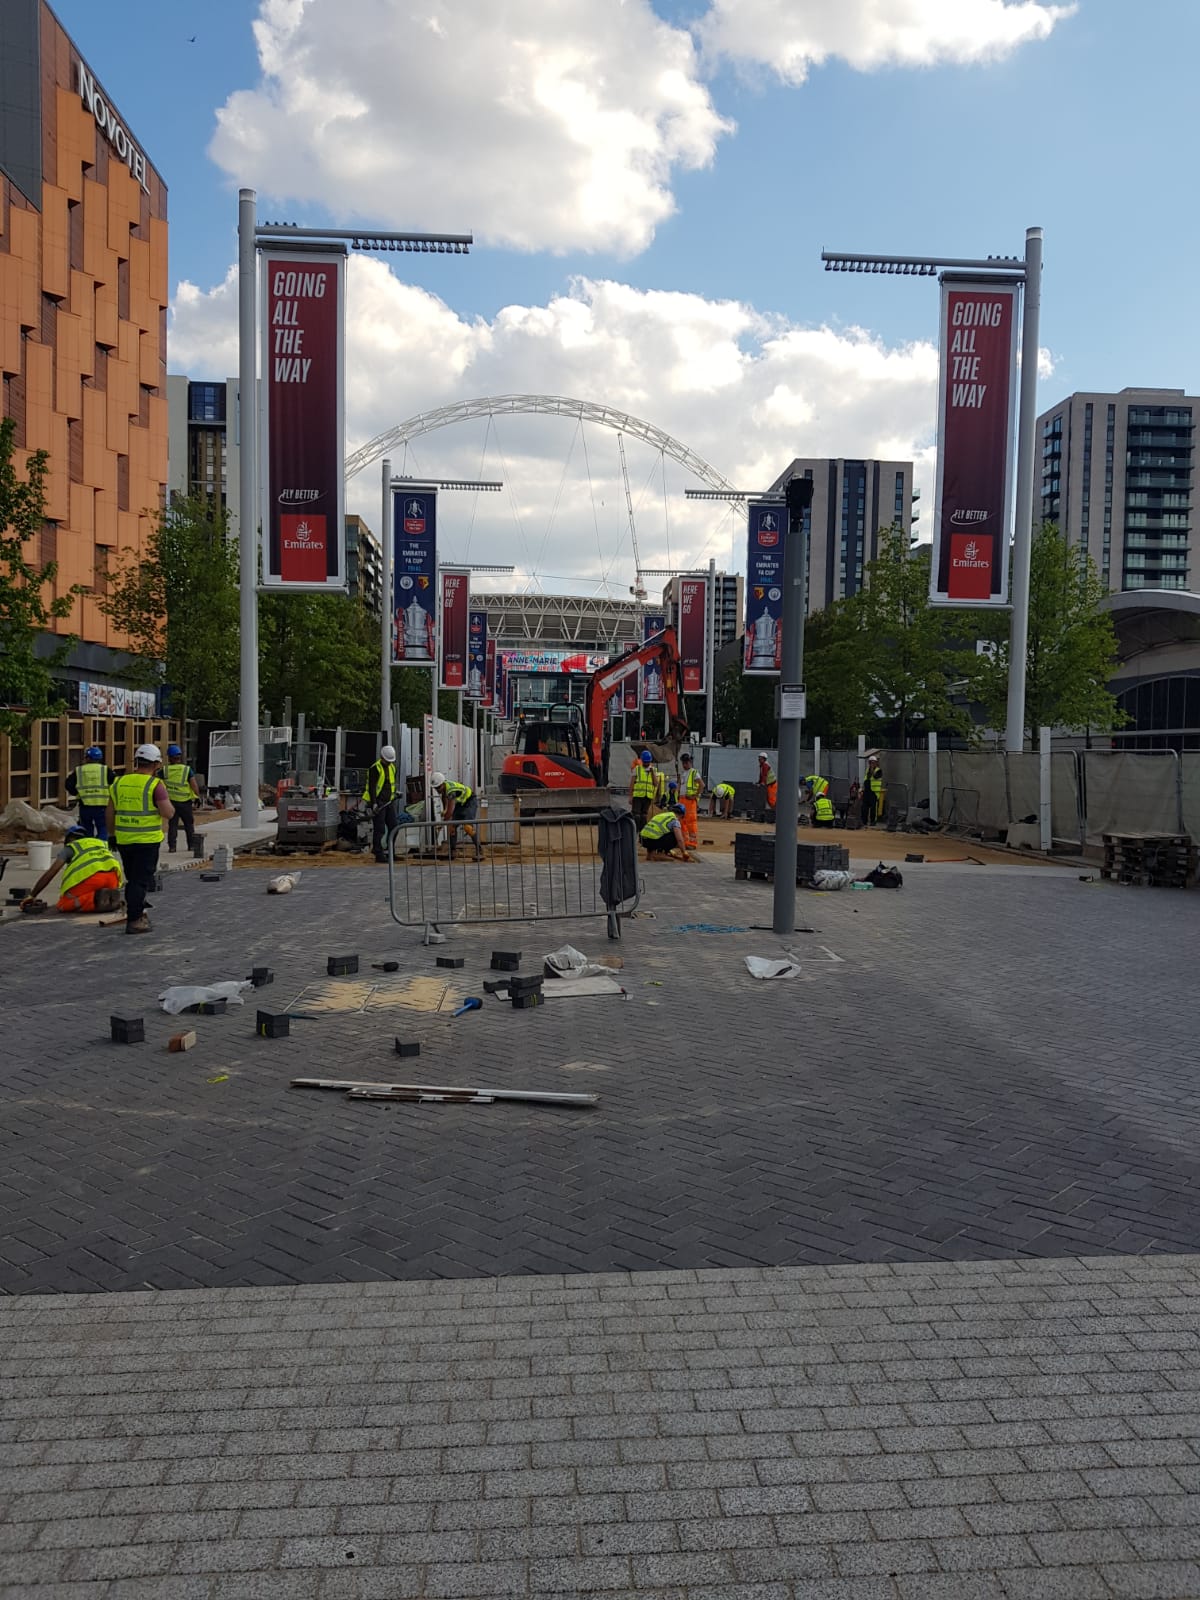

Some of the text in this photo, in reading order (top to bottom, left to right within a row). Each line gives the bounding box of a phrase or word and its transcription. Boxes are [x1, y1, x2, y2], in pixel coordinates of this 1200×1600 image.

[80, 60, 151, 196] NOVOTEL
[273, 271, 327, 298] GOING
[272, 300, 300, 326] ALL
[952, 302, 1003, 327] GOING
[274, 329, 305, 354] THE
[951, 329, 977, 353] ALL
[275, 357, 312, 384] WAY
[952, 356, 981, 381] THE
[952, 383, 987, 409] WAY
[283, 488, 320, 500] FLY BETTER
[954, 509, 988, 521] FLY BETTER
[284, 540, 324, 550] Emirates
[952, 558, 990, 568] Emirates
[445, 588, 456, 598] WE
[682, 584, 698, 594] HERE
[444, 598, 454, 608] GO
[683, 594, 693, 604] WE
[682, 604, 691, 614] GO
[507, 656, 558, 665] ANNE-MARIE
